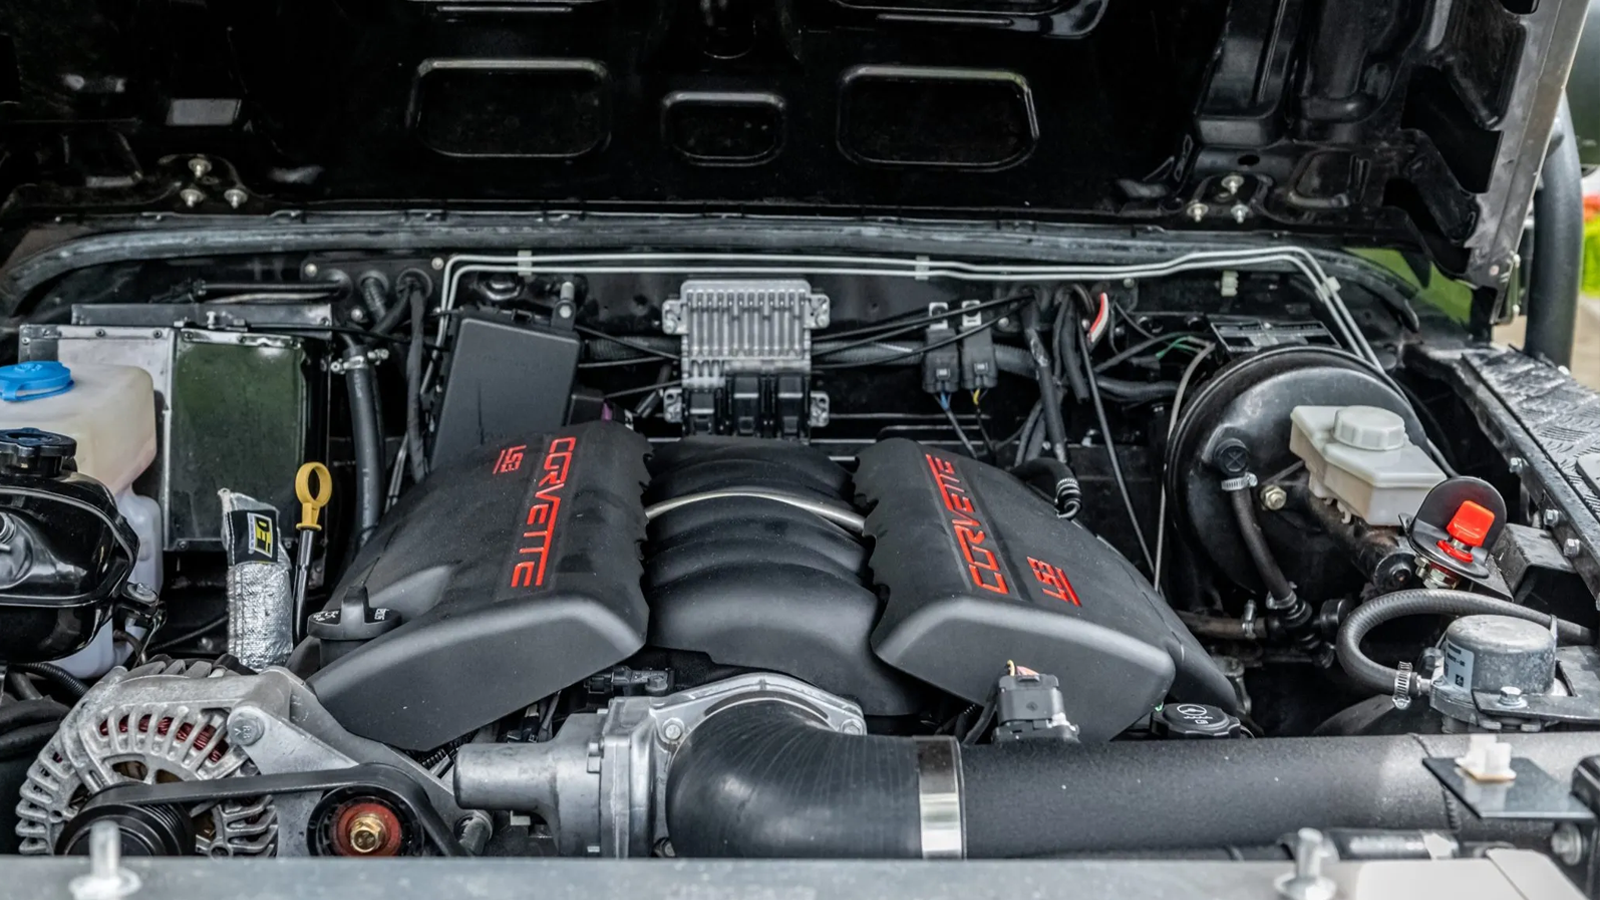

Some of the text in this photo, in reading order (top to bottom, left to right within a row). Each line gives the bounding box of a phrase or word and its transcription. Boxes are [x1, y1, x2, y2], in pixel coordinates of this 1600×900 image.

[493, 444, 527, 475] LS3
[510, 436, 577, 588] CORVETTE
[925, 453, 1009, 595] CORVETTE
[1027, 556, 1082, 607] LS3
